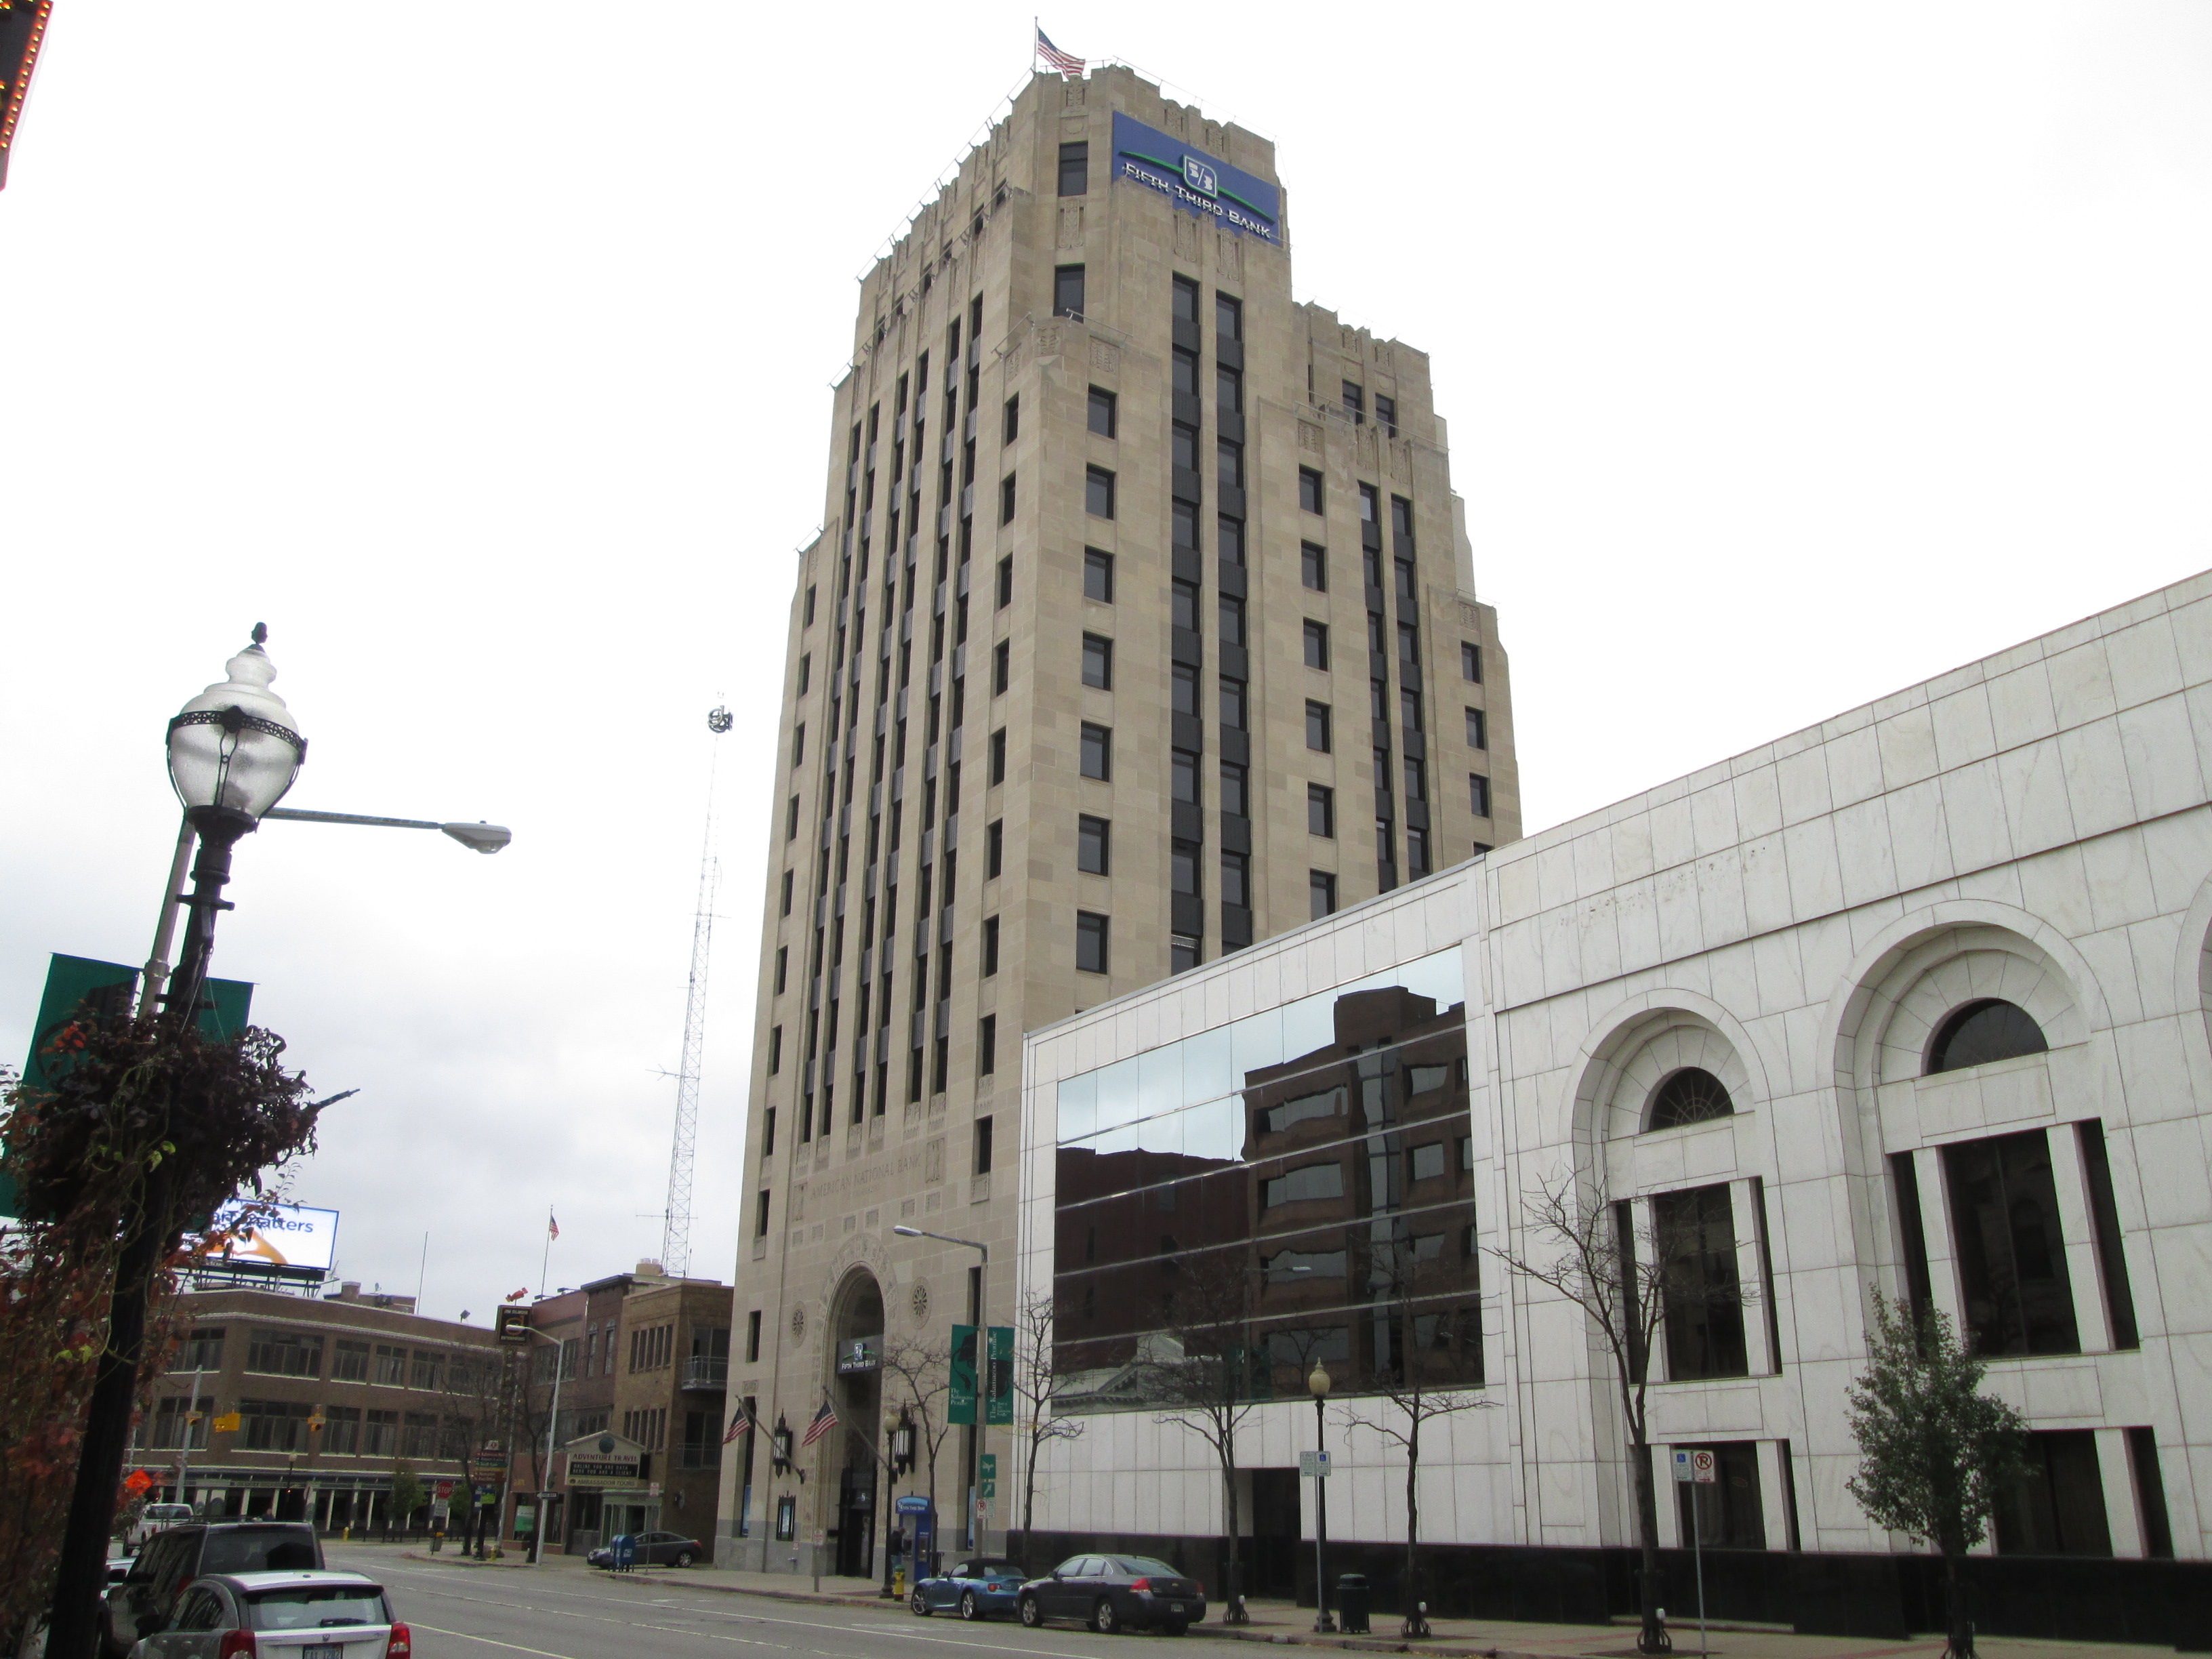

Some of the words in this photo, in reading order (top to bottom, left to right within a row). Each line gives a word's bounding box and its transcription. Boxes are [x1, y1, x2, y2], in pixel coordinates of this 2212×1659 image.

[1125, 162, 1170, 192] FIFTH
[1174, 185, 1223, 216] THIRD
[1228, 209, 1271, 239] BANK
[811, 1177, 851, 1200] AMERICAN
[855, 1162, 895, 1187] NATIONAL
[897, 1153, 921, 1174] BANK
[573, 1453, 611, 1461] ADVENTURE
